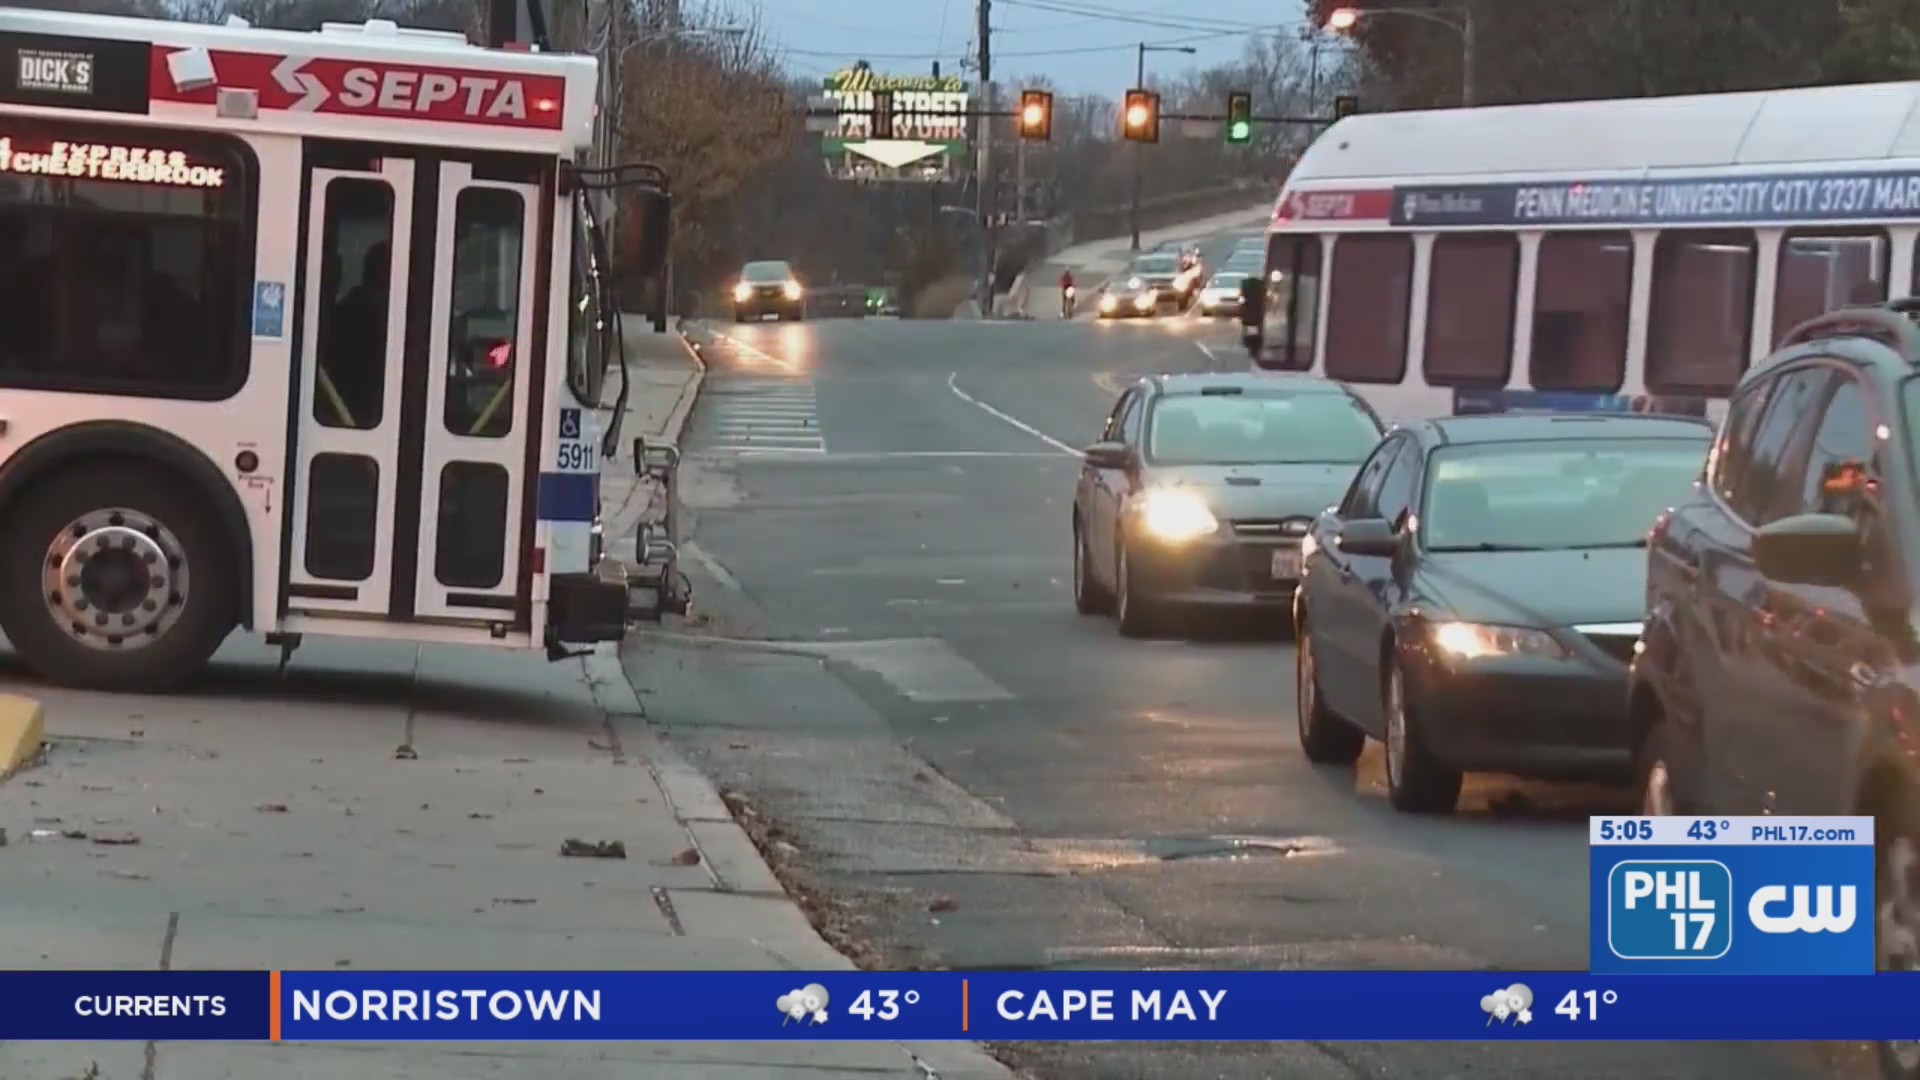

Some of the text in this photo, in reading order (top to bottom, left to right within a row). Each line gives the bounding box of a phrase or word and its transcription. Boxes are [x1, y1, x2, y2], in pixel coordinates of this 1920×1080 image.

[21, 57, 90, 84] DICK'S
[338, 67, 527, 120] SEPTA
[13, 151, 224, 187] CHESTERBROOK
[52, 141, 187, 168] EXPRESS
[1514, 187, 1566, 218] PENN
[1565, 184, 1654, 217] MEDICINE
[1655, 180, 1770, 218] UNIVERSITY
[1771, 178, 1820, 213] CITY
[1818, 177, 1873, 212] 3737
[557, 443, 594, 470] 5911
